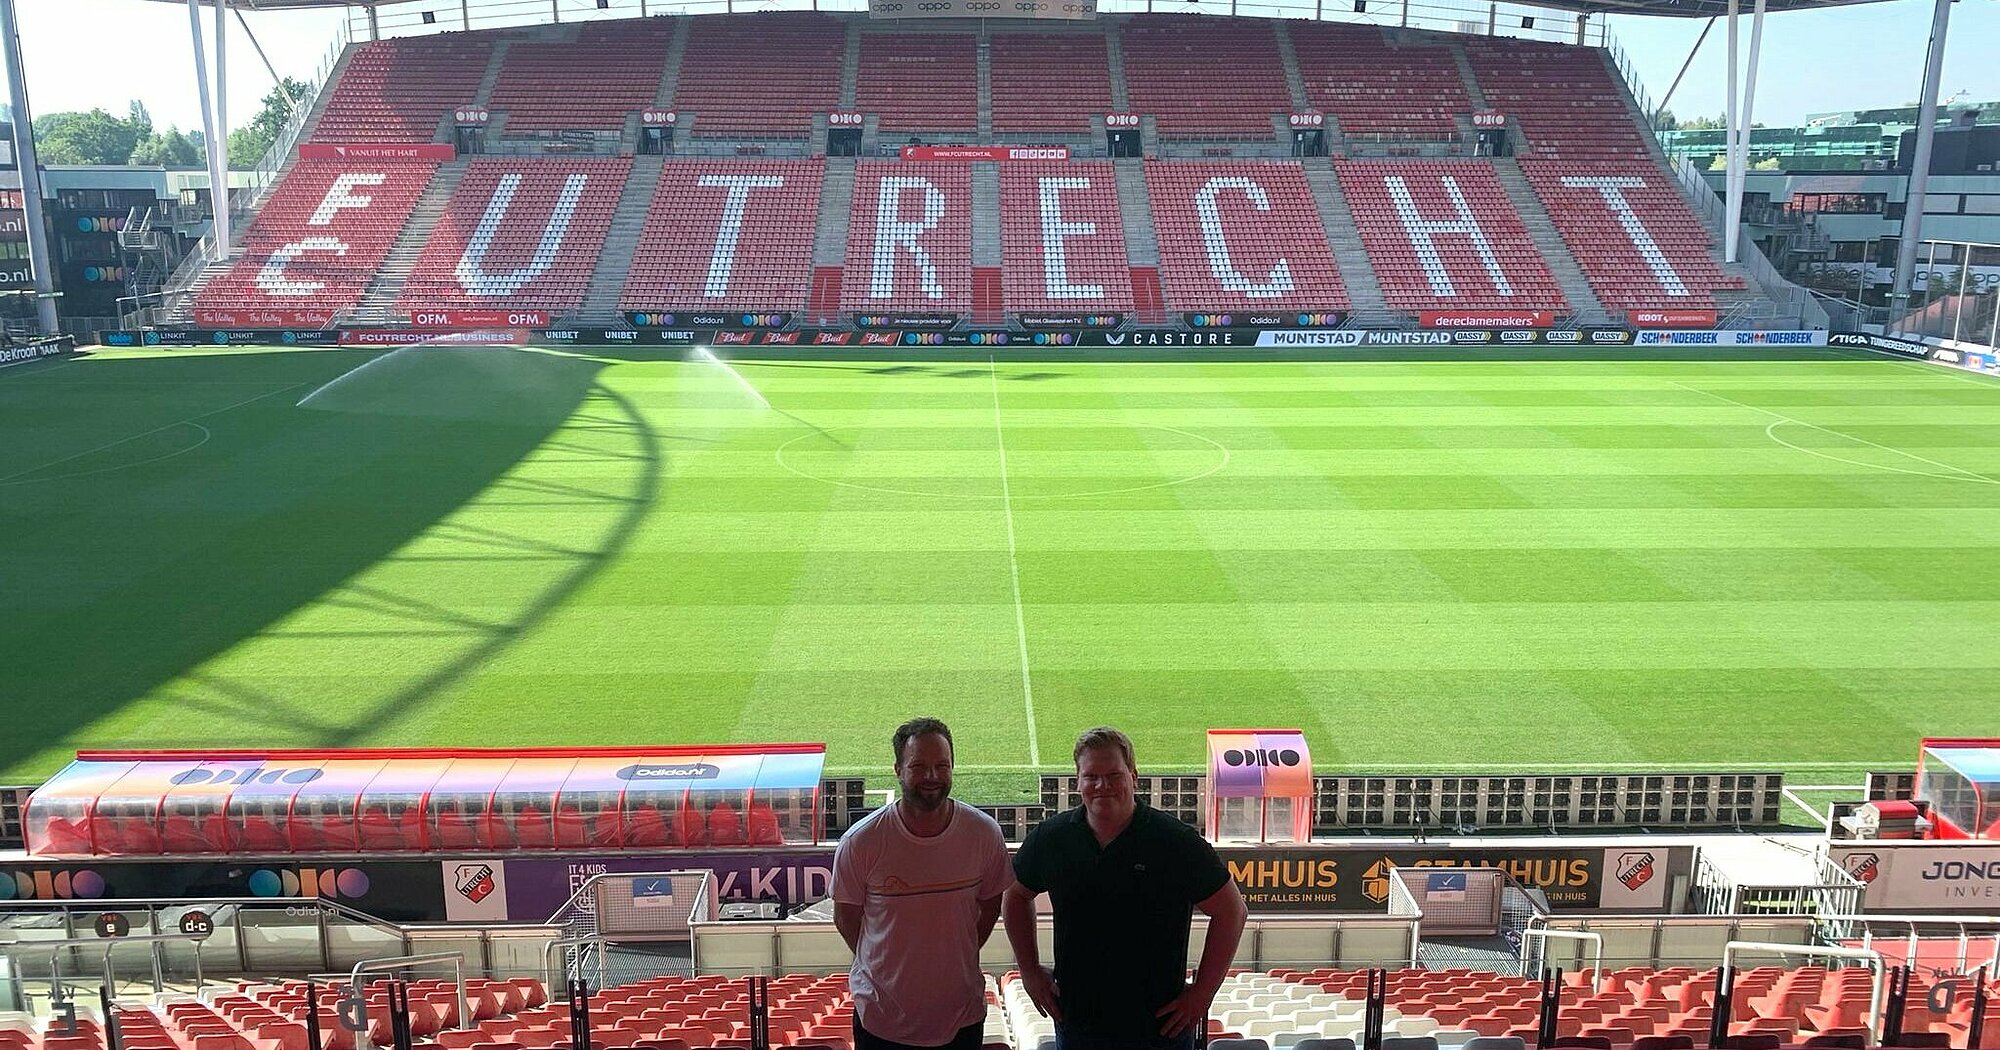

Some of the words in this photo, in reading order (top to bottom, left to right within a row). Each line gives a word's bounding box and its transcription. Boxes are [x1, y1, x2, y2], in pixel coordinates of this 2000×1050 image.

[873, 3, 903, 13] oppo
[918, 2, 952, 11] oppo
[966, 1, 1000, 11] oppo
[1015, 2, 1048, 12] oppo
[1063, 4, 1093, 13] oppo
[349, 149, 379, 157] VANUIT
[381, 149, 395, 157] HET
[397, 149, 418, 157] HART
[0, 218, 22, 232] .nl
[214, 311, 236, 325] Valley
[261, 312, 282, 326] Valley
[306, 312, 328, 325] Valley
[693, 316, 724, 325] Odido.nl
[1250, 316, 1281, 324] Odido.nl
[1435, 316, 1533, 326] dereclamemakers
[1637, 313, 1664, 322] KOOT
[229, 332, 253, 340] LINKIT
[546, 331, 579, 339] UNIBET
[605, 331, 638, 339] UNIBET
[661, 331, 695, 339] UNIBET
[721, 332, 746, 342] Bud
[767, 332, 792, 342] Bud
[819, 332, 843, 342] Bud
[867, 332, 890, 342] Bud
[1133, 333, 1232, 345] CASTORE
[1274, 333, 1356, 344] MUNTSTAD
[1368, 332, 1451, 344] MUNTSTAD
[1829, 334, 1868, 344] STIGA
[1870, 336, 1929, 355] TUINGEREEDSCHAP
[1626, 856, 1633, 866] F
[1851, 856, 1858, 866] F
[464, 868, 470, 878] F
[568, 865, 577, 874] IT
[578, 865, 585, 874] 4
[586, 864, 607, 874] KIDS
[1227, 860, 1338, 888] MHUIS
[1414, 859, 1590, 887] HUIS
[750, 866, 833, 904] KID
[1552, 892, 1562, 900] IN
[1565, 892, 1587, 900] HUIS
[1945, 886, 2000, 898] INVE
[1249, 893, 1268, 902] MET
[1270, 893, 1300, 902] ALLES
[1302, 893, 1311, 902] IN
[1314, 893, 1337, 902] HUIS
